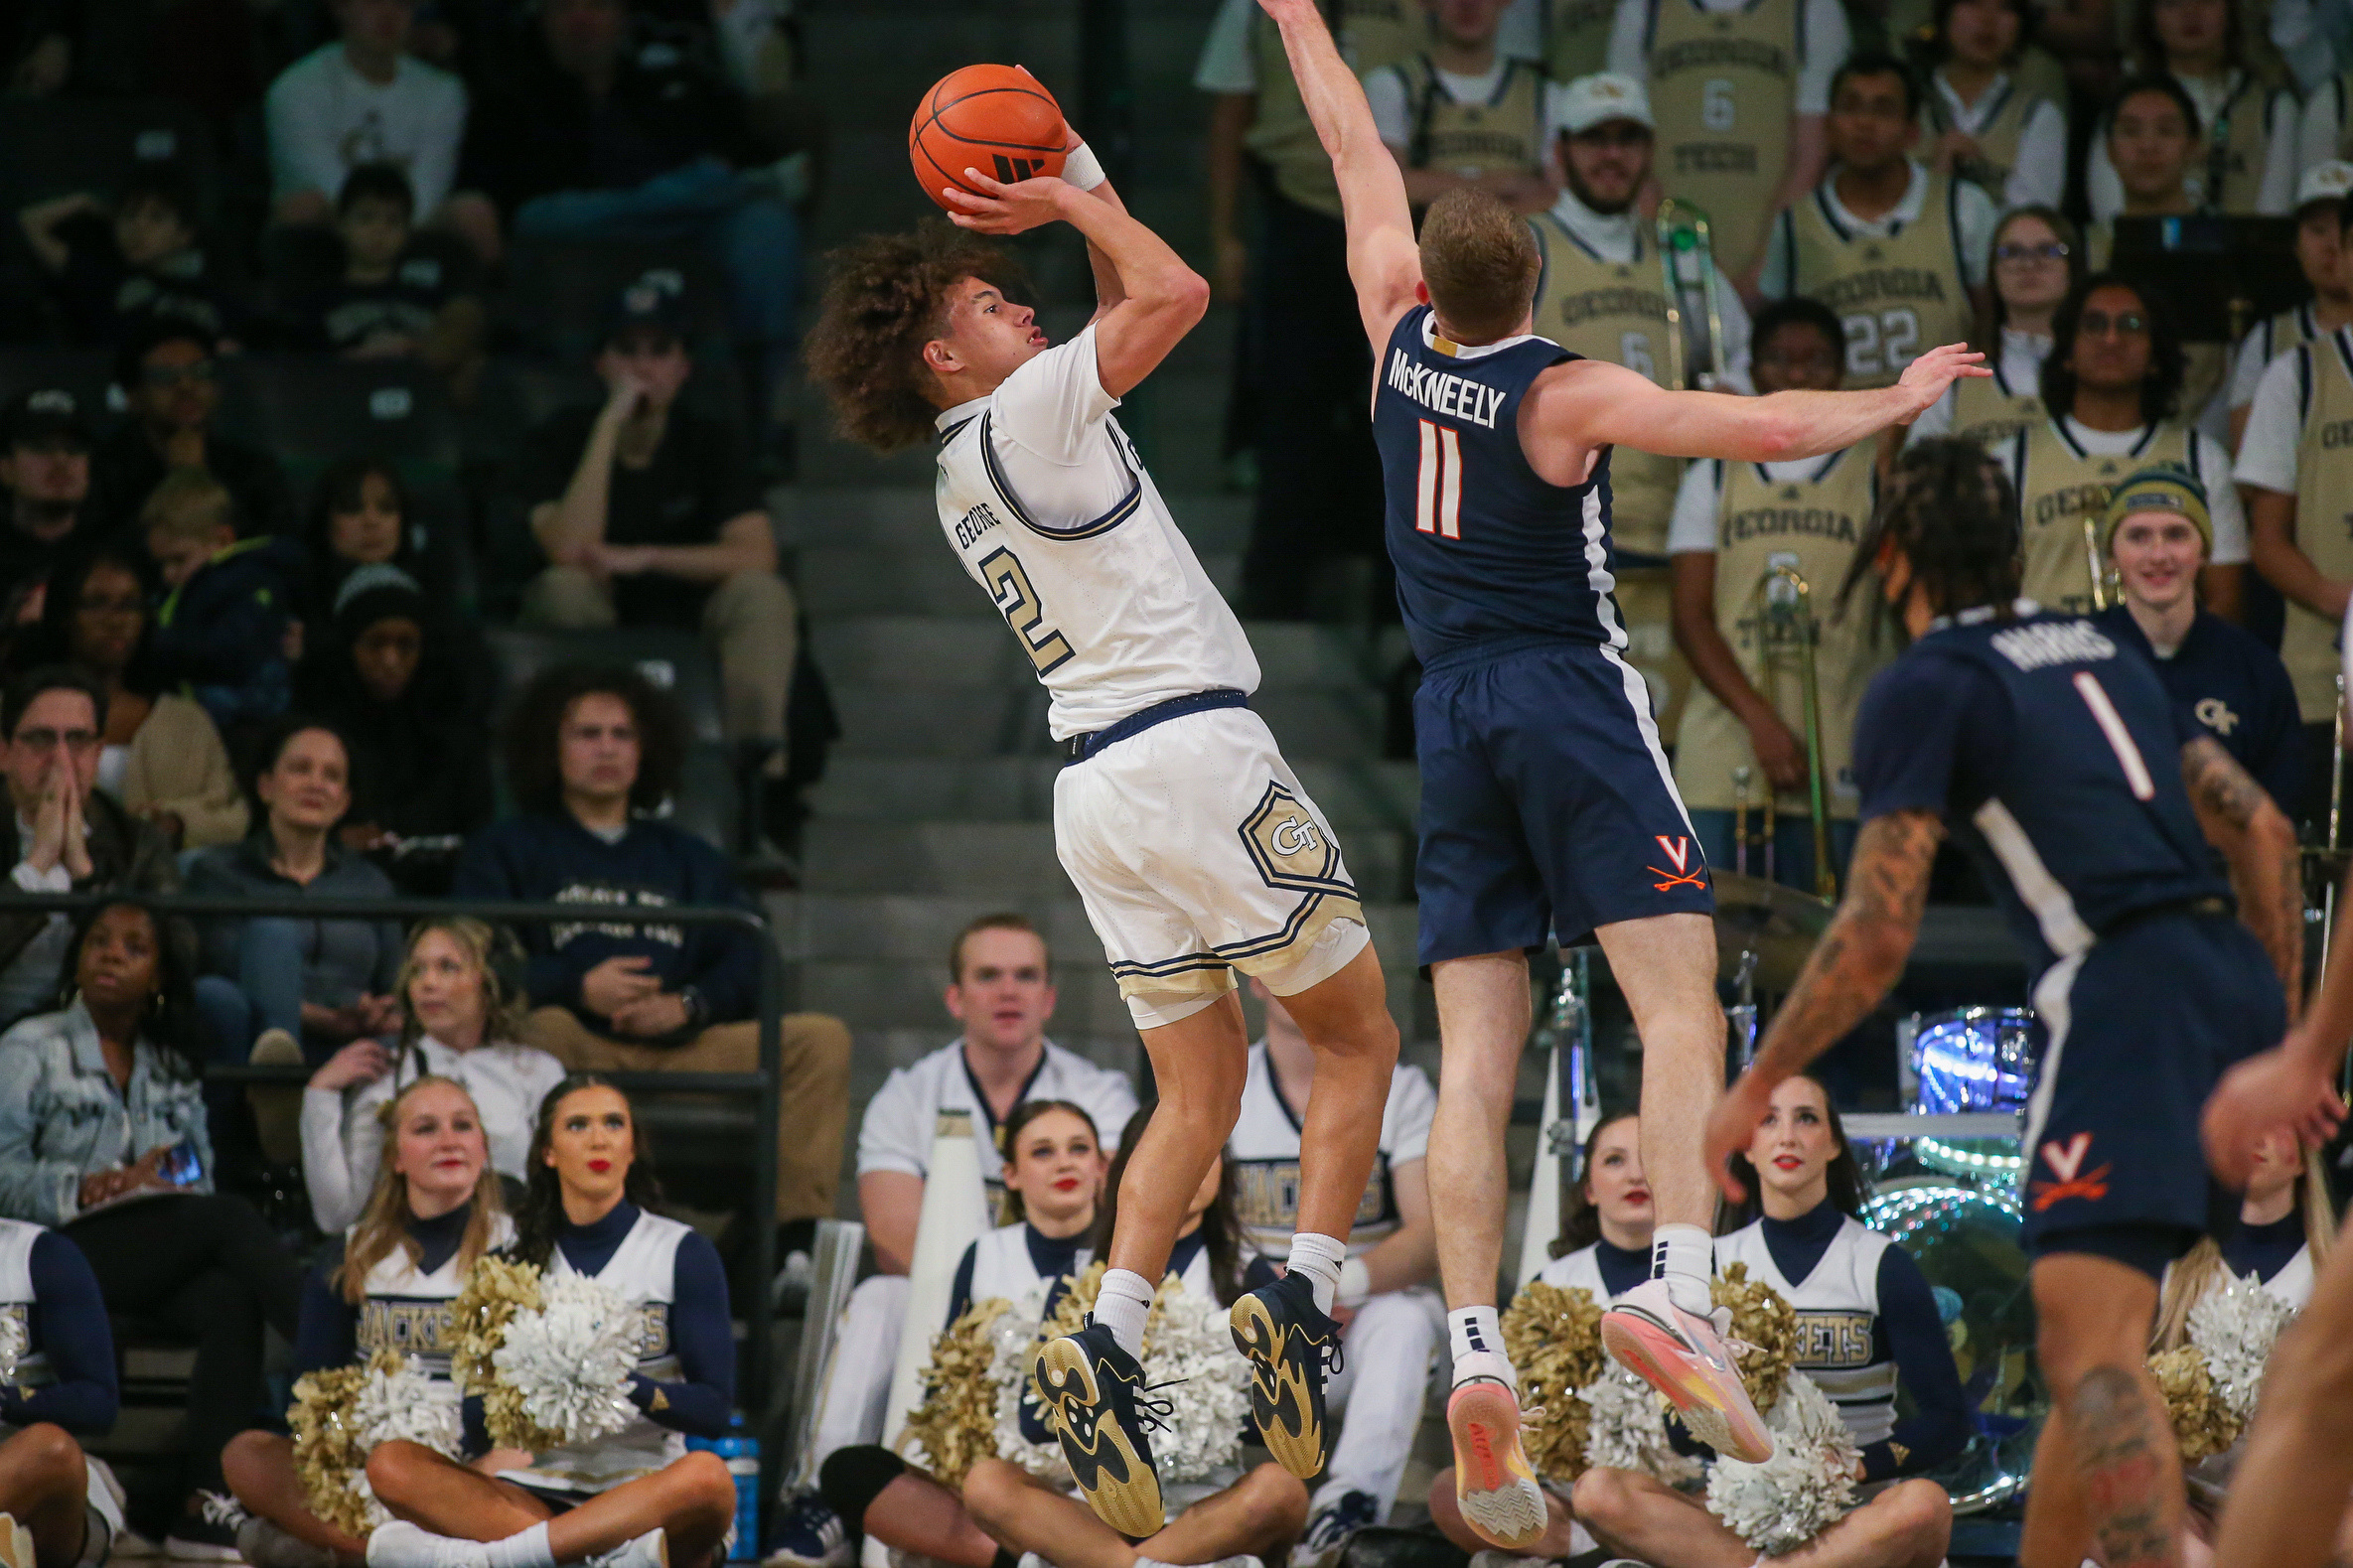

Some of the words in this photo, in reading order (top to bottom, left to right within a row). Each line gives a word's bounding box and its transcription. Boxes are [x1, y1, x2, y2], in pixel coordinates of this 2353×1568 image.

[1702, 78, 1735, 131] 6
[1389, 348, 1506, 429] McKNEELY
[1842, 309, 1919, 375] 22
[1415, 418, 1463, 540] 11
[978, 545, 1076, 678] 2
[2073, 670, 2154, 801] 1
